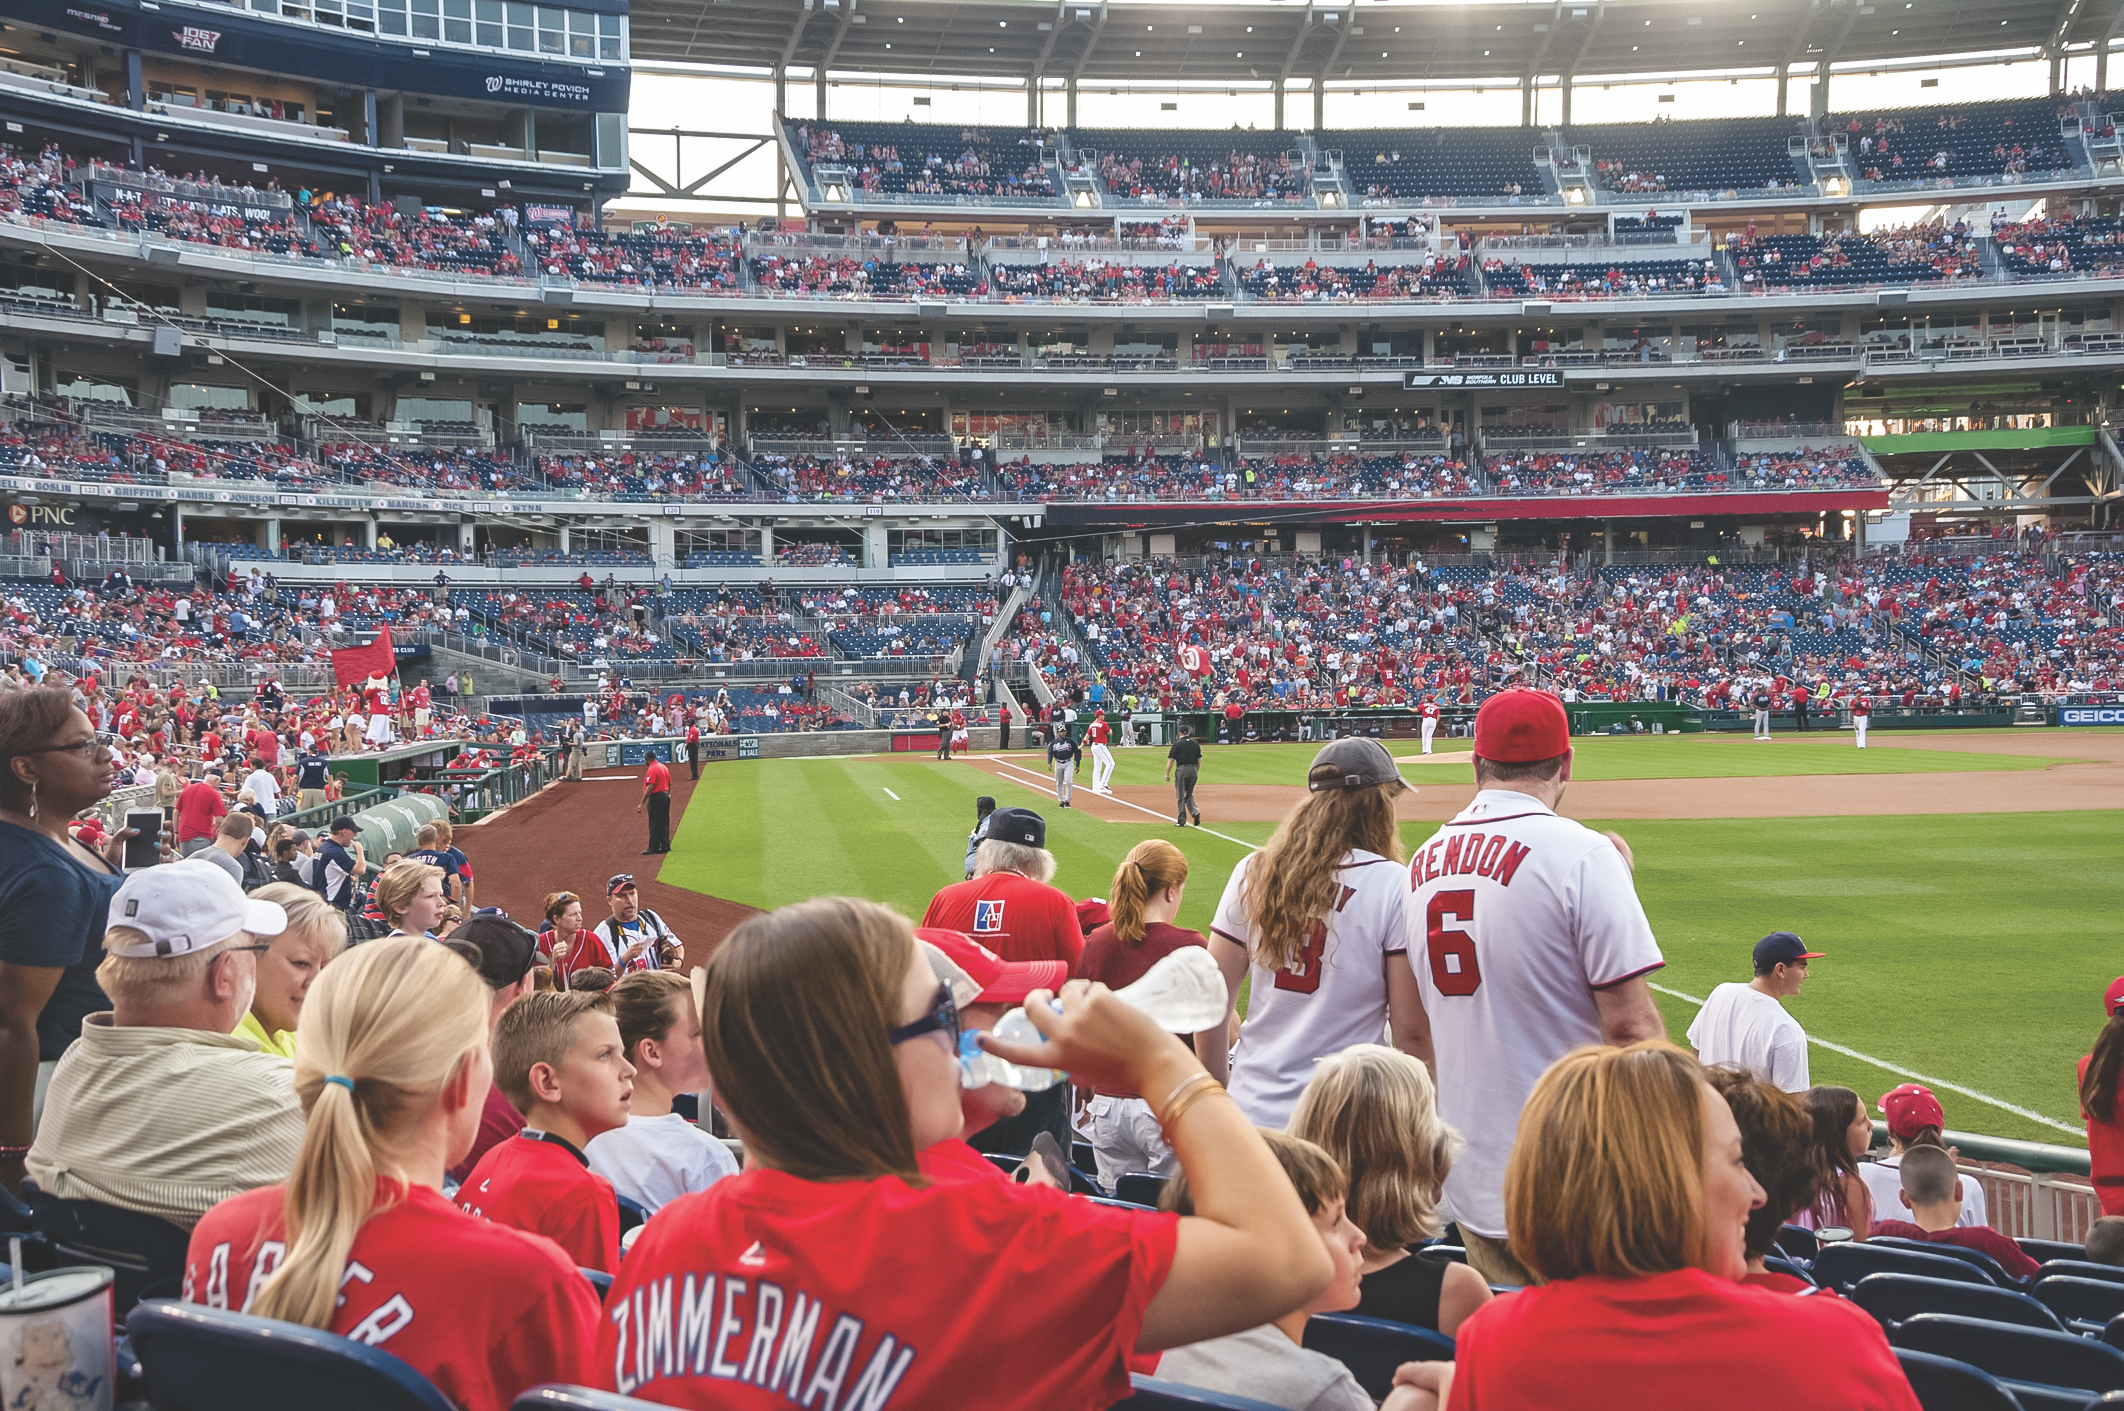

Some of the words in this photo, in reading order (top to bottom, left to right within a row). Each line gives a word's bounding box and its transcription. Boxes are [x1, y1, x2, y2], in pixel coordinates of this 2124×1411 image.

[182, 37, 215, 50] FAN
[504, 86, 540, 95] MEDIA
[544, 90, 589, 101] CENTER
[505, 78, 549, 89] SHIRLEY
[552, 83, 589, 94] POVICH
[244, 207, 271, 219] WOO!
[1500, 374, 1526, 385] CLUB
[1529, 373, 1558, 385] LEVEL
[35, 481, 72, 493] GOSLIN
[115, 489, 163, 498] GRIFFITH
[178, 492, 215, 500] HARRIS
[229, 493, 275, 503] JOHNSON
[316, 498, 373, 507] KILLEBREW
[388, 501, 429, 509] MANUSH
[513, 504, 542, 512] WYNN
[30, 506, 75, 526] PNC
[698, 740, 738, 748] ATIONALS
[1411, 833, 1532, 893] RENDON
[1427, 889, 1482, 997] 6
[611, 1270, 917, 1411] ZIMMERMAN
